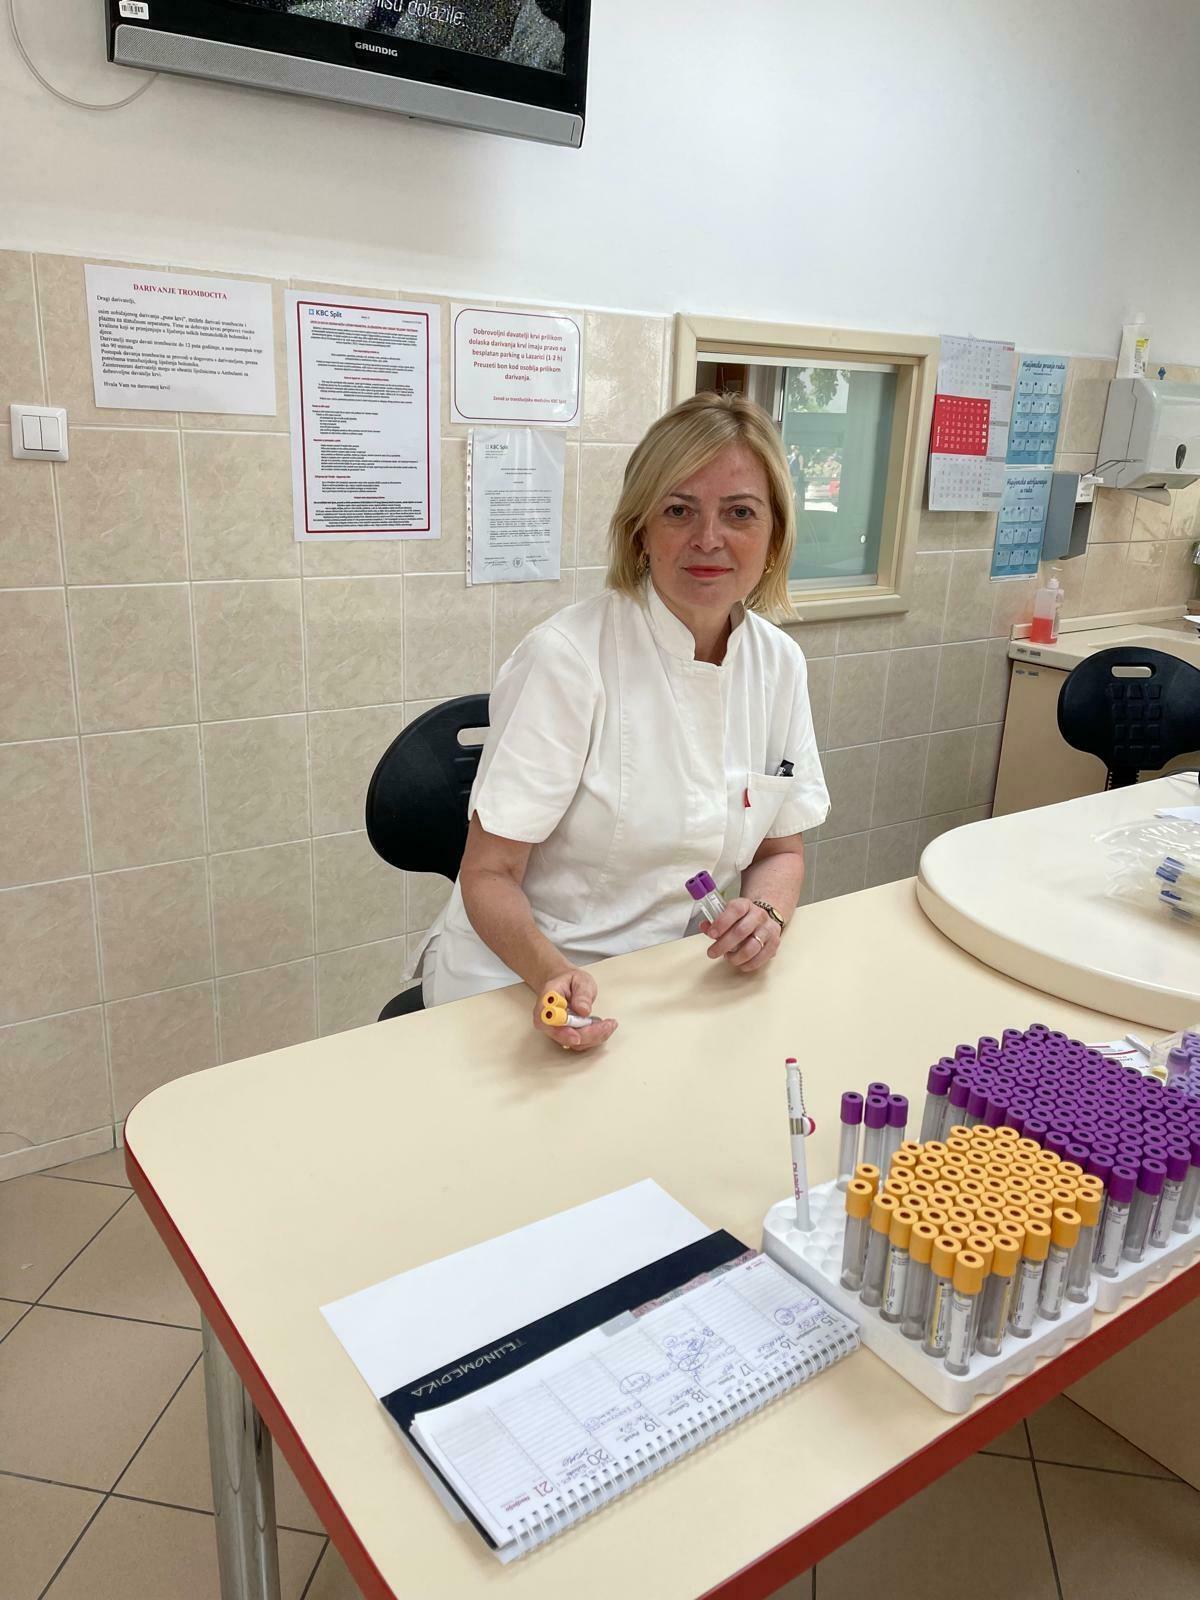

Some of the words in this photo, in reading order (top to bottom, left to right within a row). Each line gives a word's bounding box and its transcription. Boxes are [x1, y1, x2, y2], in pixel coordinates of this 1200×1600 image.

[354, 42, 398, 57] GRUNDIG
[133, 284, 176, 294] DARIVANJE
[178, 289, 227, 299] TROMBOCITA
[315, 309, 329, 317] KBC
[330, 310, 342, 319] Split
[473, 328, 505, 337] Dobrovoljni
[506, 331, 529, 339] davatelji
[541, 334, 563, 342] prilikom
[469, 338, 490, 346] dolaska
[491, 340, 515, 349] darivanja
[528, 343, 542, 351] imaju
[472, 349, 499, 358] besplatan
[500, 351, 520, 360] parking
[474, 361, 496, 369] Preuzeti
[520, 365, 539, 373] osoblja
[540, 366, 561, 374] prilikom
[504, 373, 531, 382] darivanja.
[821, 1314, 838, 1327] 15
[780, 1338, 798, 1351] 16
[740, 1363, 753, 1377] 17
[691, 1389, 710, 1403] 18
[644, 1418, 661, 1433] 19
[586, 1448, 609, 1466] 20
[532, 1480, 553, 1497] 21
